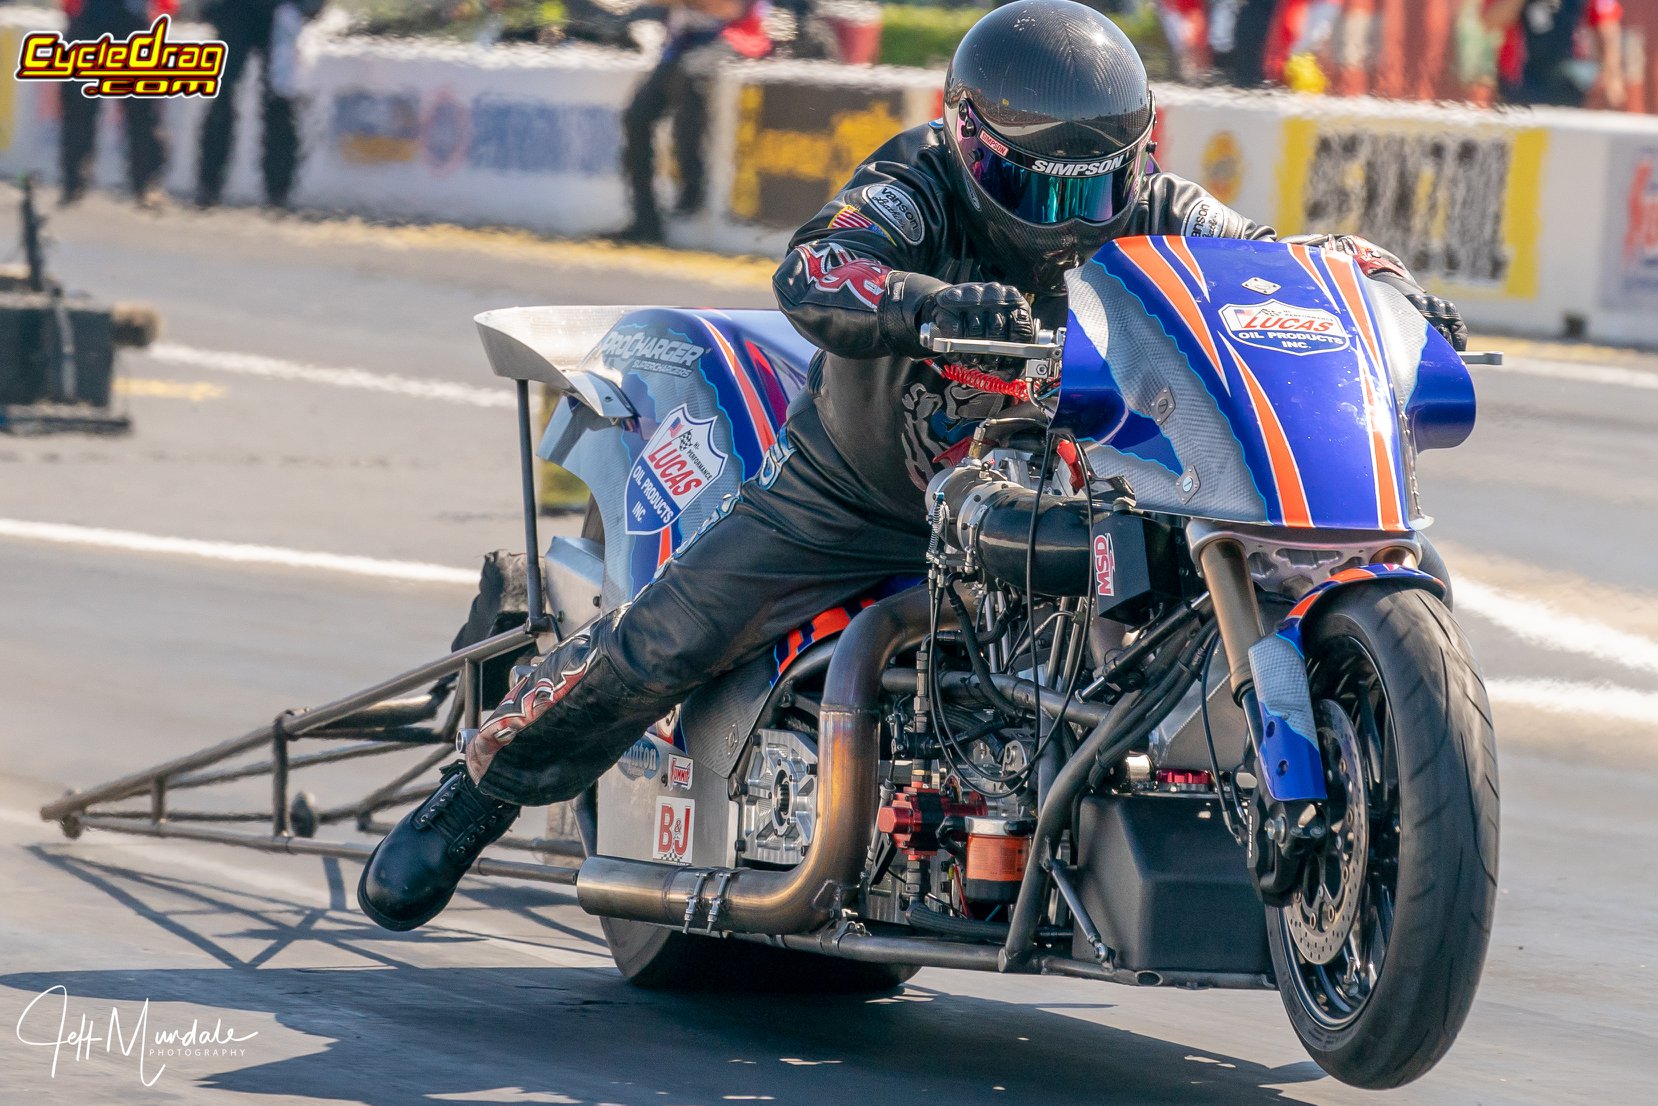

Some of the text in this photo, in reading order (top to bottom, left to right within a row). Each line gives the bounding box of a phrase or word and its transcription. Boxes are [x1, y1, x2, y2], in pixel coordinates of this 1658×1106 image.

[981, 131, 1007, 156] SIMPSON
[1032, 155, 1125, 176] SIMPSON
[1191, 203, 1210, 237] anson
[1238, 331, 1344, 345] OIL PRODUCTS
[1243, 315, 1334, 332] LUCAS
[1281, 340, 1312, 349] INC.
[647, 441, 703, 496] LUCAS
[686, 449, 713, 481] PERFORMANCE
[632, 465, 674, 523] OIL PRODUCTS
[1094, 535, 1112, 595] MSD
[658, 804, 691, 856] B&J
